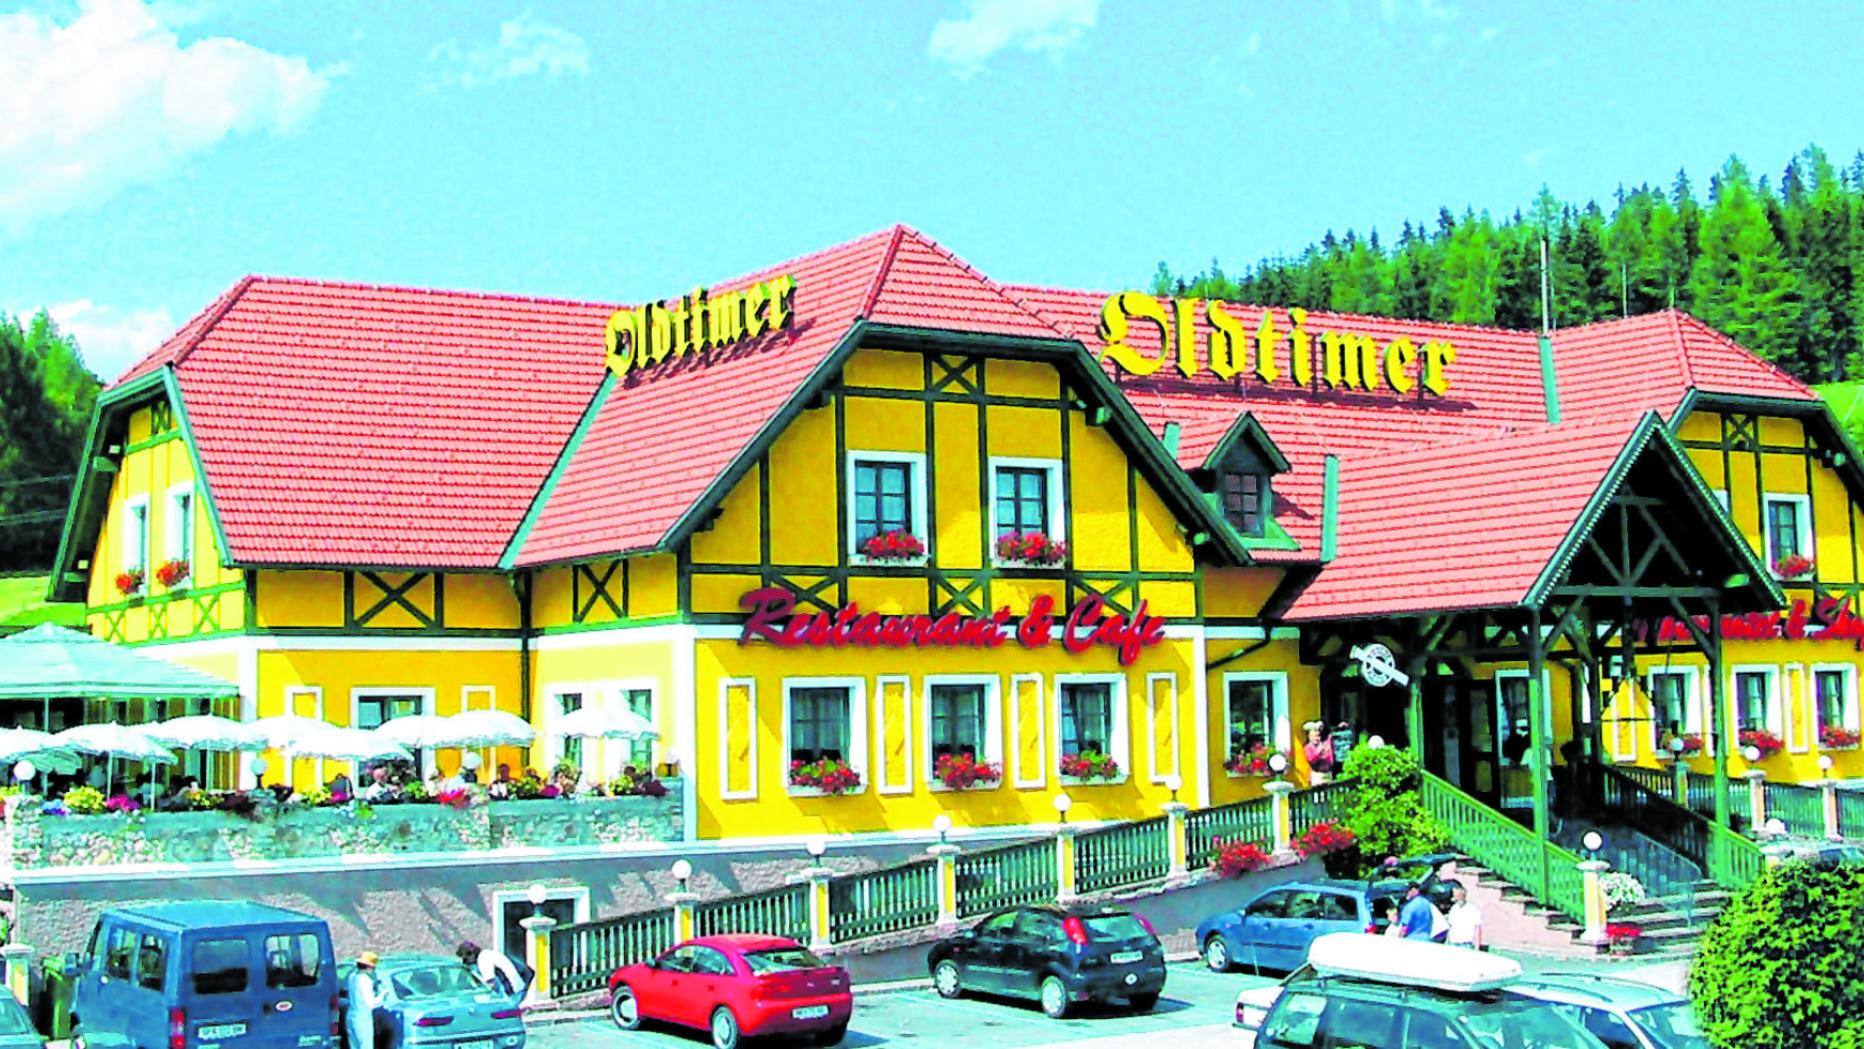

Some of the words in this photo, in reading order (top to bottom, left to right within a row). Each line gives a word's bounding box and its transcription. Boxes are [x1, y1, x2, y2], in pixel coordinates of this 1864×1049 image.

[605, 273, 796, 377] Oldtimer
[1098, 291, 1456, 397] Oldtimer
[738, 586, 1011, 648] Restaurant
[1016, 594, 1055, 649] &
[1063, 592, 1166, 666] Cafe
